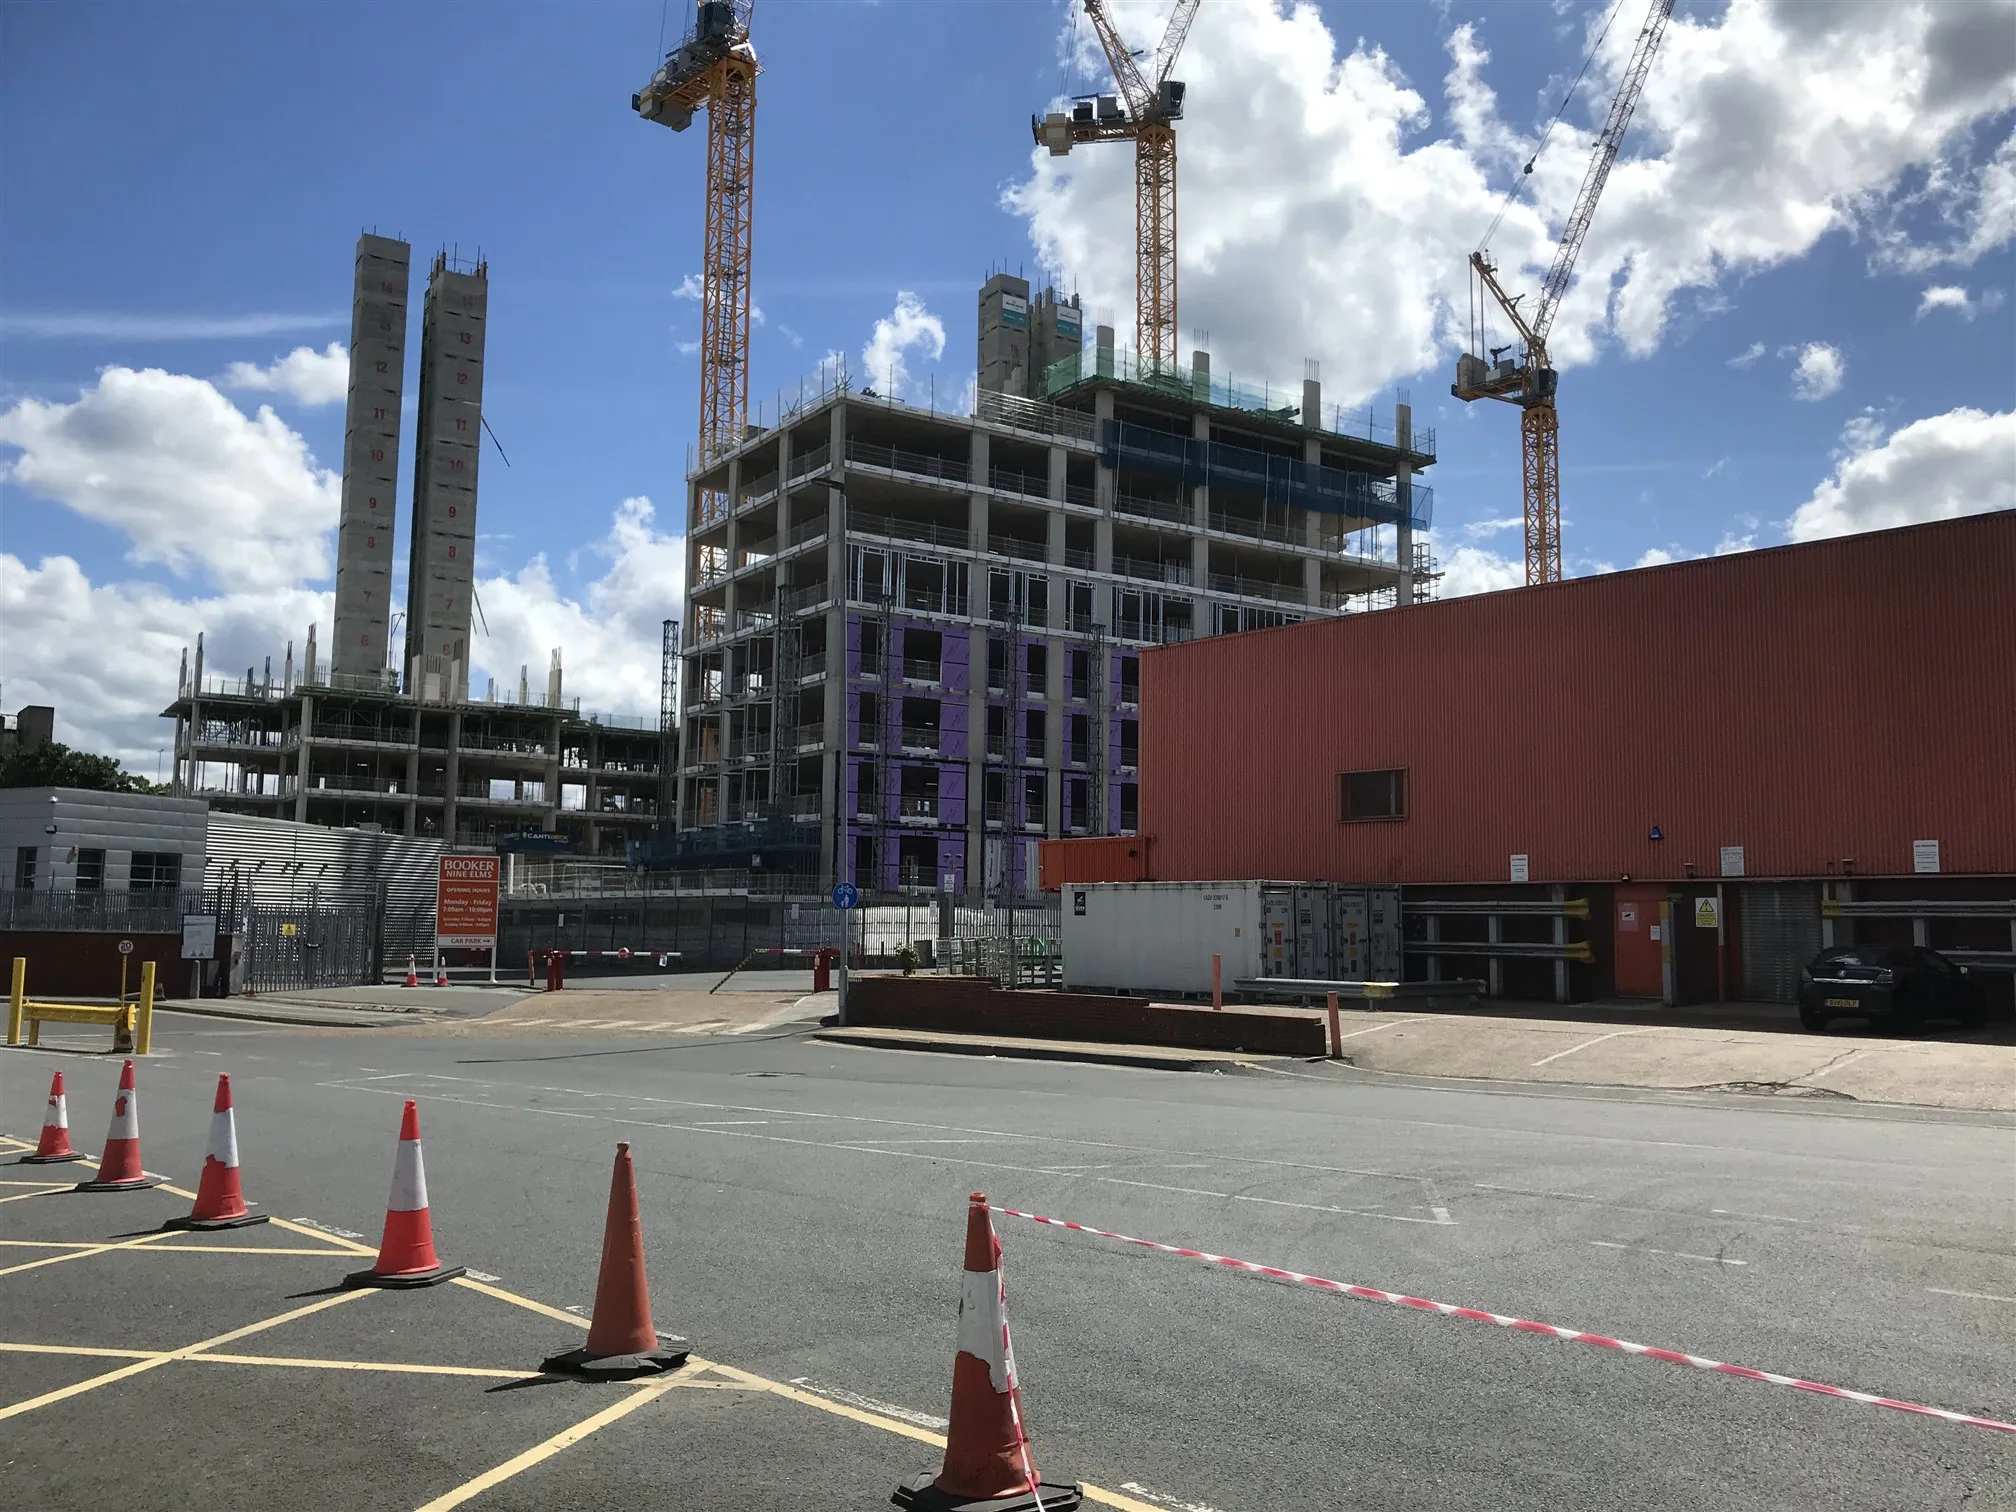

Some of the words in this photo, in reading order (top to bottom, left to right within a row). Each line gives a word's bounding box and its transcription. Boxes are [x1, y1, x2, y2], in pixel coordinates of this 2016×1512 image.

[459, 332, 471, 345] 13
[375, 361, 388, 374] 12
[456, 372, 468, 385] 12
[373, 407, 385, 420] 11
[455, 418, 467, 431] 11
[370, 449, 384, 462] 10
[450, 459, 463, 471] 10
[368, 497, 377, 509] 9
[448, 506, 456, 518] 9
[444, 860, 495, 871] BOOKER
[446, 870, 467, 878] NINE
[469, 870, 492, 878] ELMS
